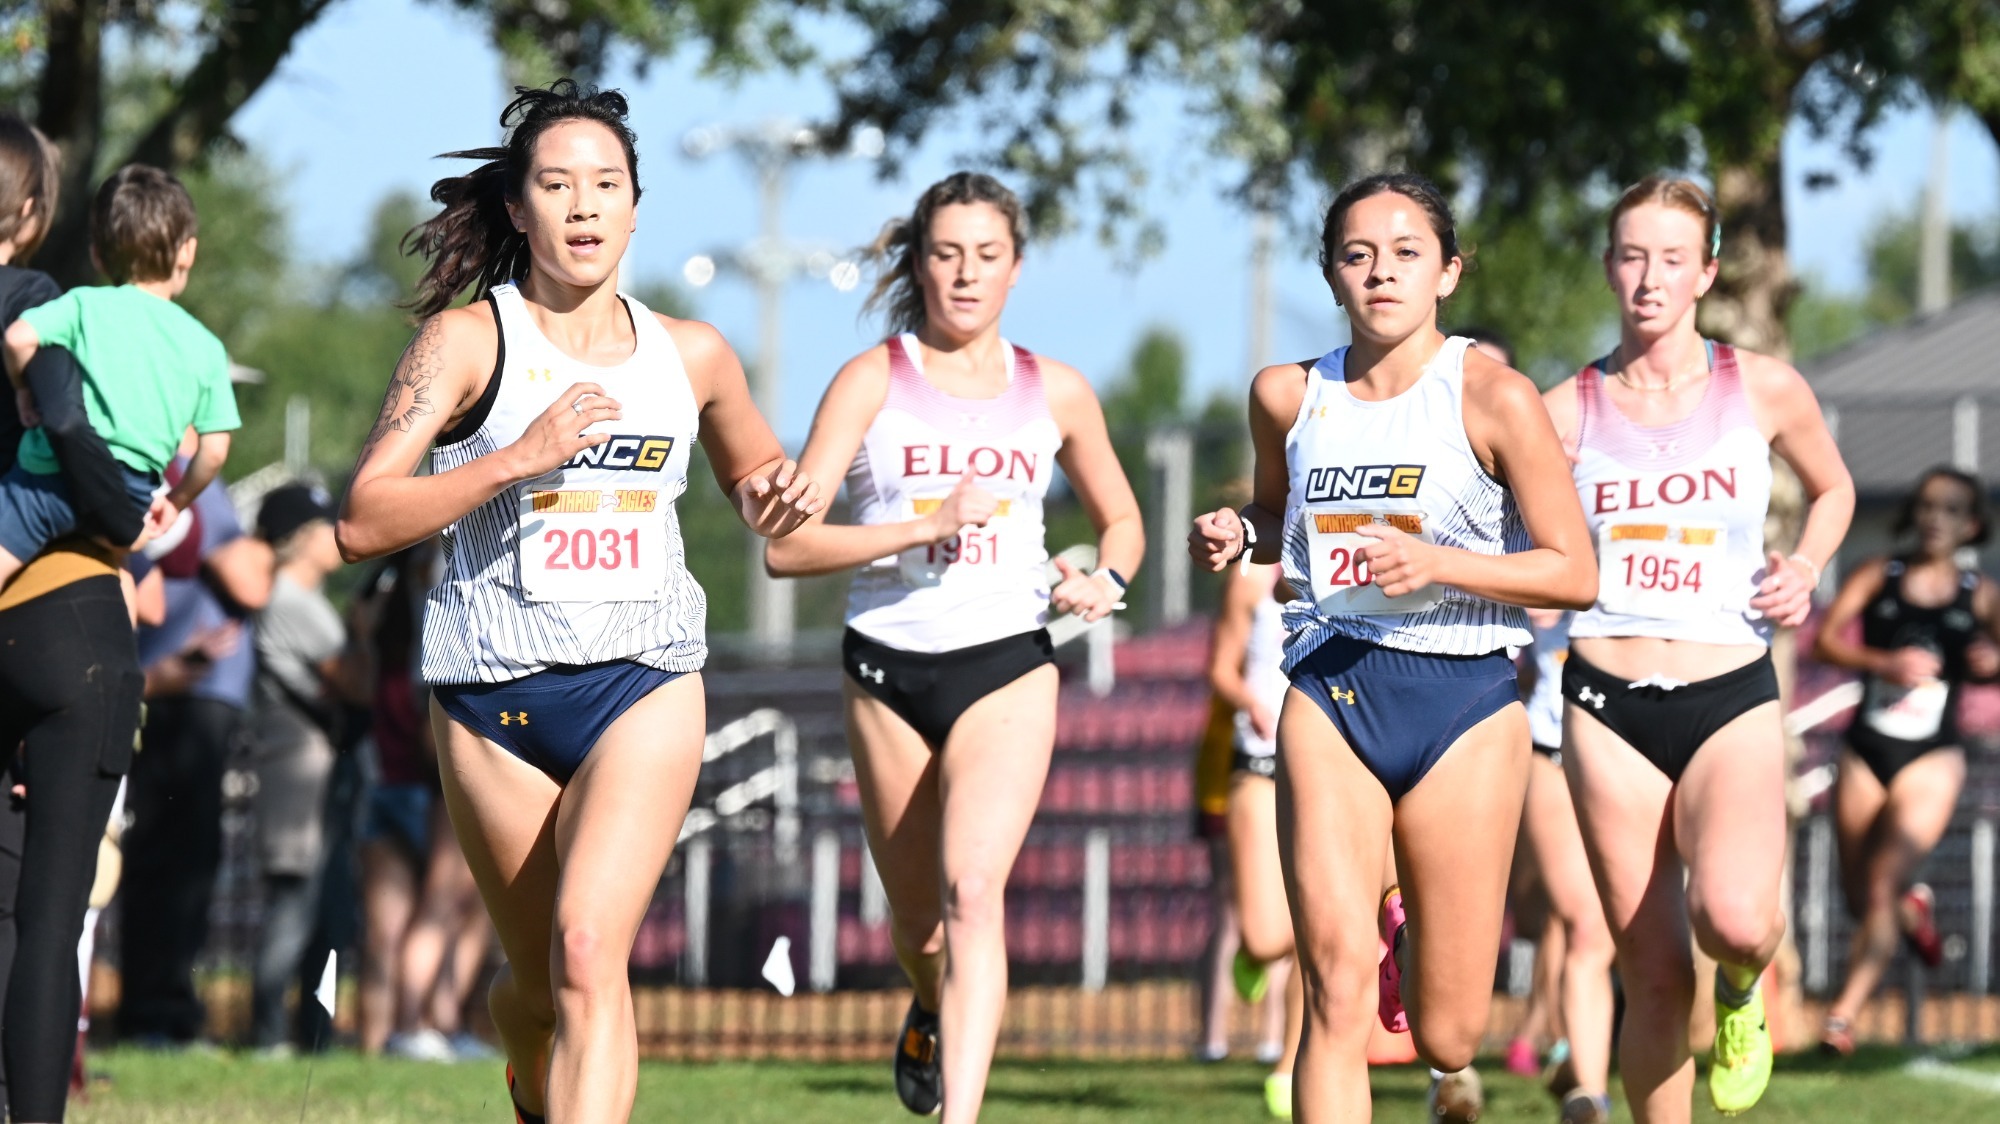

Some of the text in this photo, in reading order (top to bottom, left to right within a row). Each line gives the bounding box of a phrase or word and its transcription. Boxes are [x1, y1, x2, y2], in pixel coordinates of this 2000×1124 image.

[559, 434, 675, 472] NCG
[902, 445, 1038, 484] ELON
[532, 490, 657, 513] WINTHROP EAGLES
[1305, 464, 1427, 503] UNCG
[1594, 467, 1736, 515] ELON
[543, 528, 639, 570] 2031
[926, 532, 998, 565] 1951
[1329, 547, 1374, 586] 20
[1621, 553, 1702, 593] 1954
